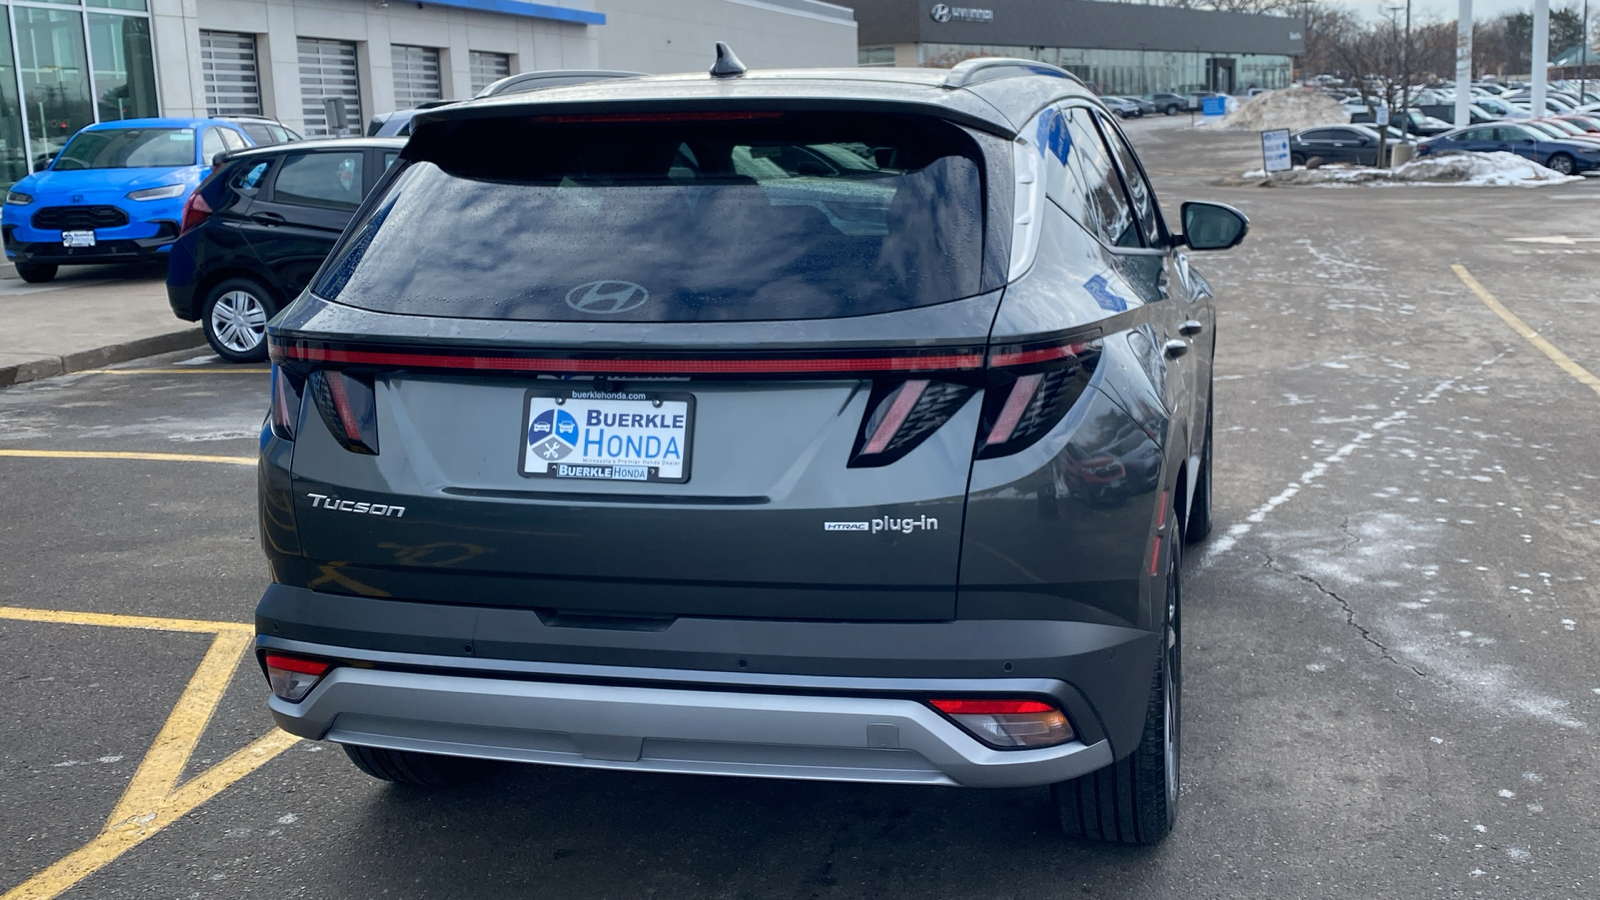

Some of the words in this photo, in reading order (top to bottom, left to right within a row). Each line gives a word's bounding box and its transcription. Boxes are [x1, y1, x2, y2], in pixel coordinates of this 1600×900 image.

[572, 390, 646, 400] buerklehonda.com
[586, 409, 685, 429] BUERKLE
[583, 428, 681, 459] HONDA
[826, 522, 867, 530] HTRAC
[871, 514, 939, 534] plug-in
